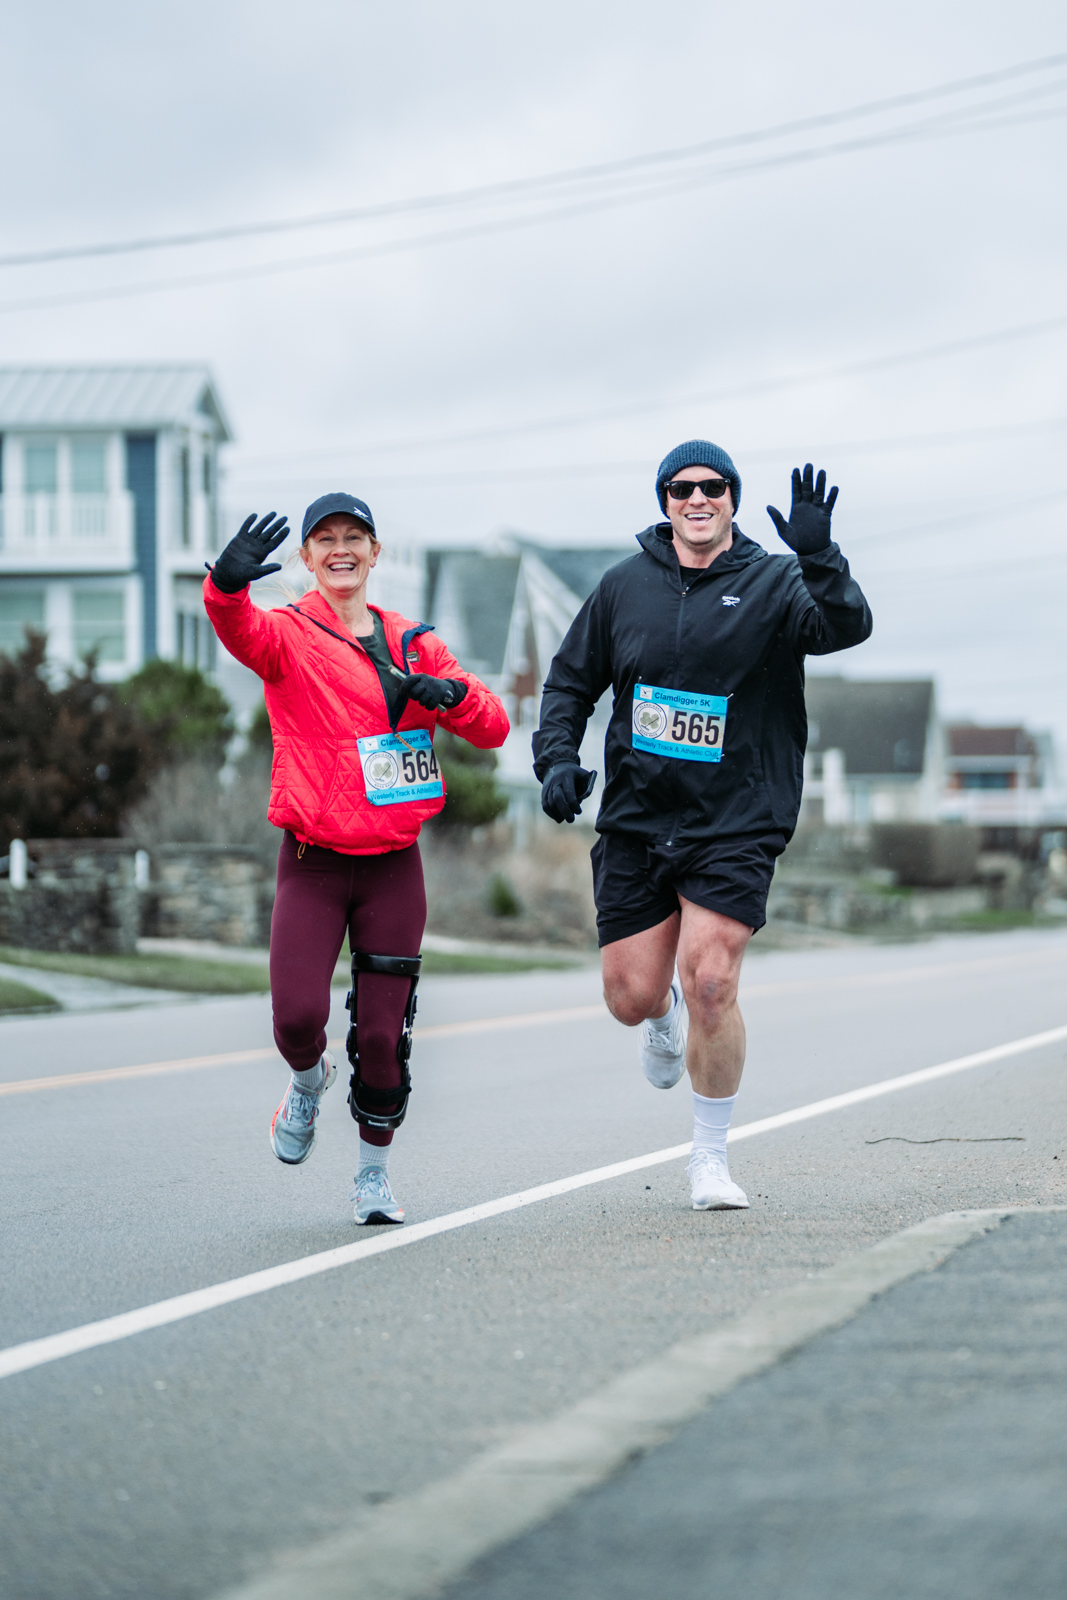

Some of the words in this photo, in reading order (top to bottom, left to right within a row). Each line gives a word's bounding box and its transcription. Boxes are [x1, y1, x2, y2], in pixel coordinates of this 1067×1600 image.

[654, 692, 698, 705] Clamdigger
[671, 710, 720, 746] 565
[658, 743, 673, 751] Track
[704, 750, 719, 758] Club
[402, 749, 438, 783] 564
